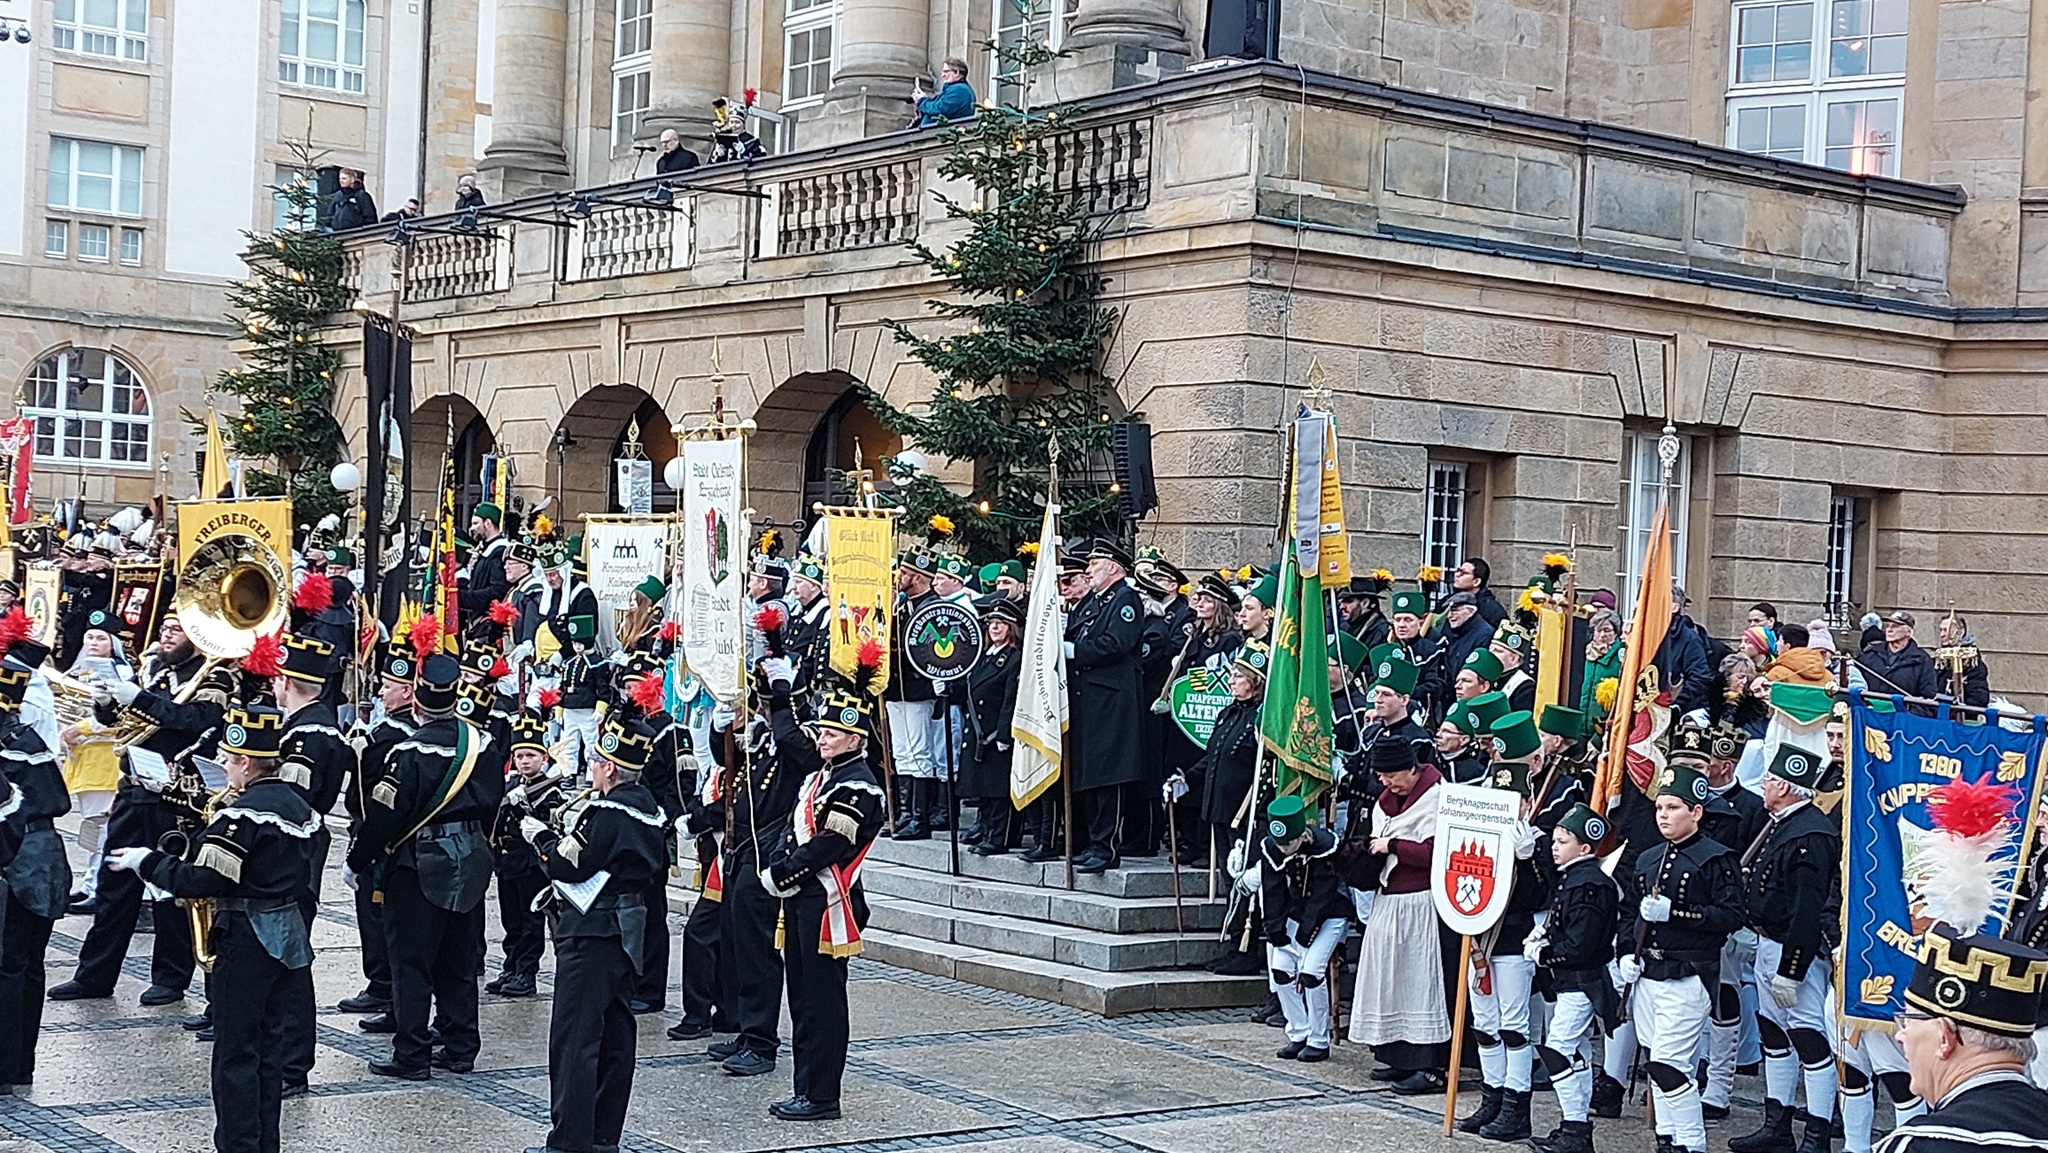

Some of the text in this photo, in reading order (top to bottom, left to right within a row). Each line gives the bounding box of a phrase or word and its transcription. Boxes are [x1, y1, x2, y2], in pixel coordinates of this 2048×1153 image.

[194, 512, 273, 545] FREIBERGER
[601, 561, 654, 576] Knappschaft
[1034, 593, 1058, 724] Bergbautraditionsve
[926, 663, 964, 677] Wismut
[1185, 692, 1234, 706] KNAPPENVE
[1178, 702, 1224, 720] ALTEN
[1918, 752, 1962, 779] 1380
[1446, 794, 1510, 813] Bergknappschaft
[1438, 806, 1516, 826] Johanngeorgenstadt
